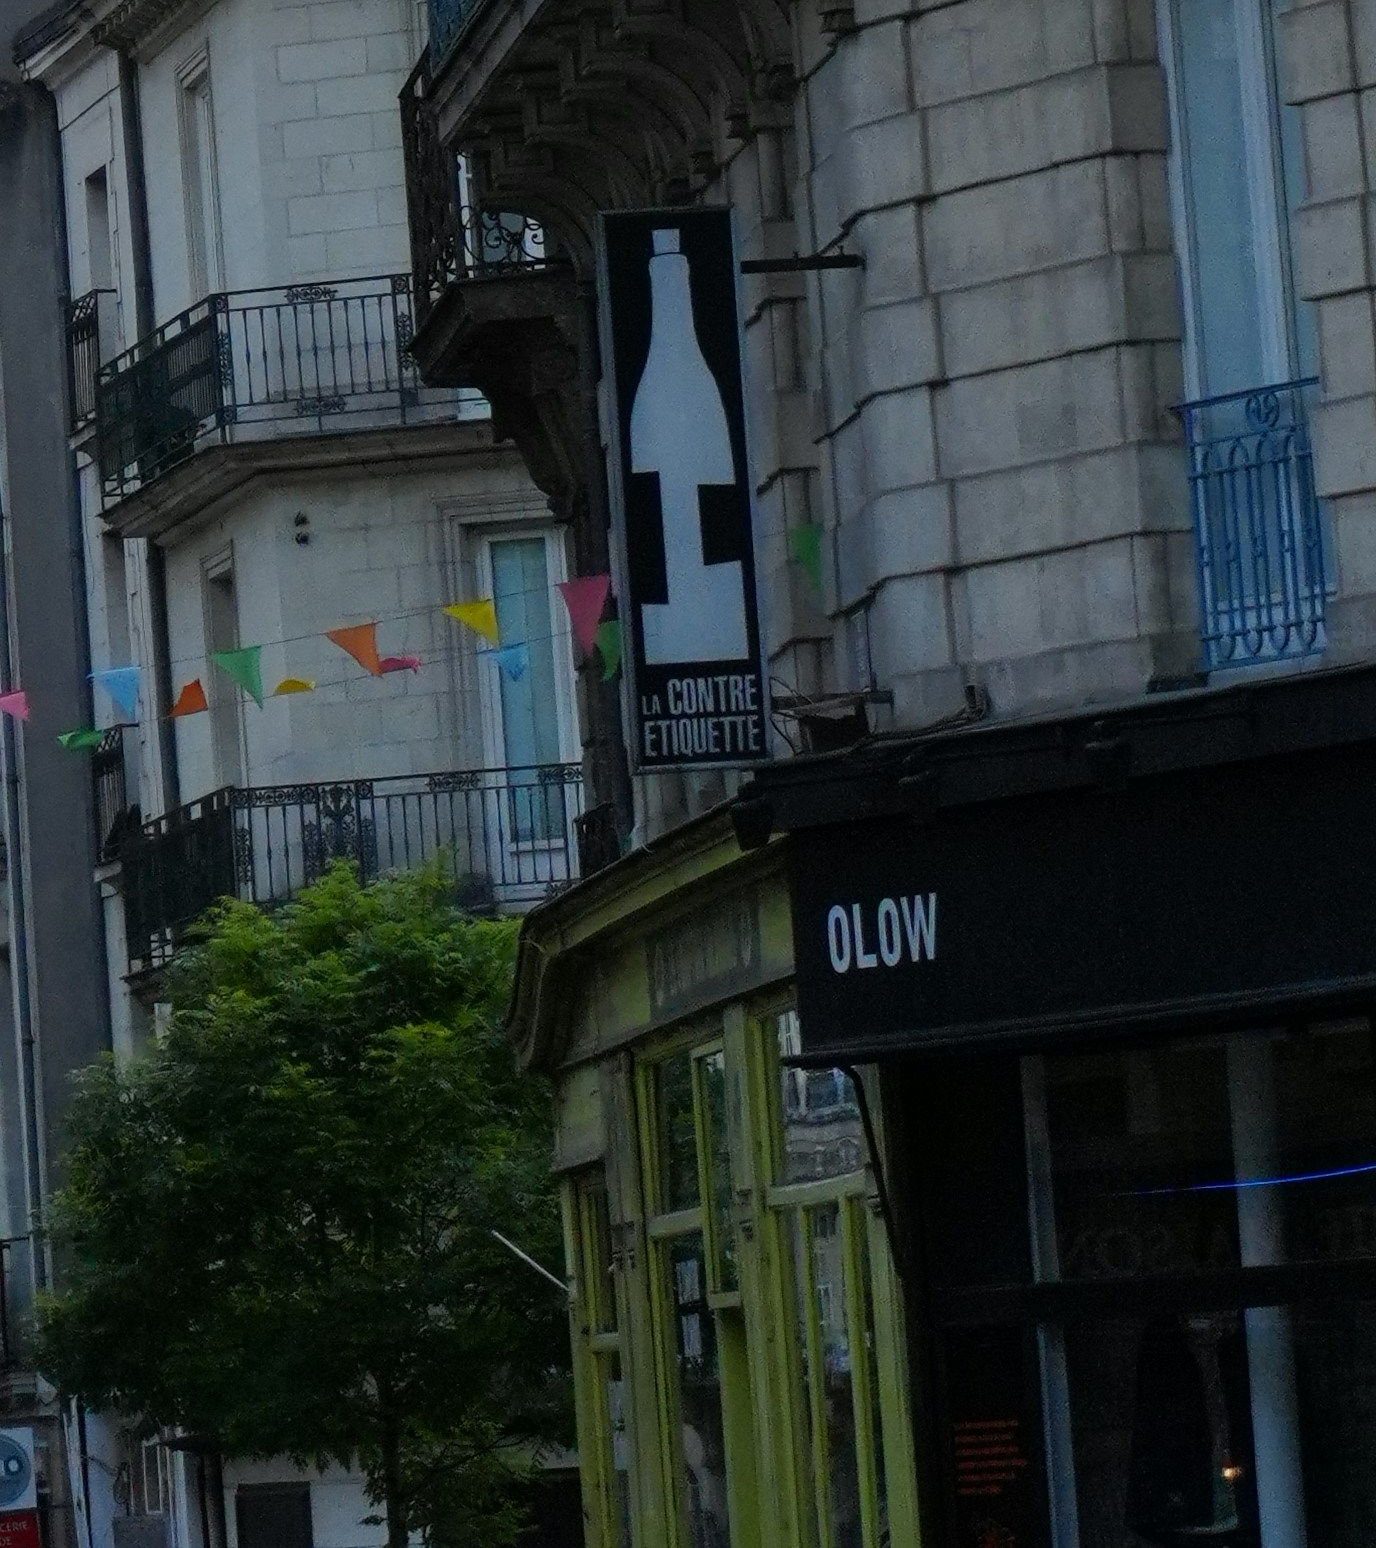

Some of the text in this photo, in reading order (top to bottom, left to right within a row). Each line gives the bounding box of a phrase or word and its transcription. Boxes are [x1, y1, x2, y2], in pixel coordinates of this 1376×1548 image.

[642, 674, 758, 715] LA CONTRE
[644, 715, 761, 757] ETIQUETTE
[828, 892, 937, 973] OLOW
